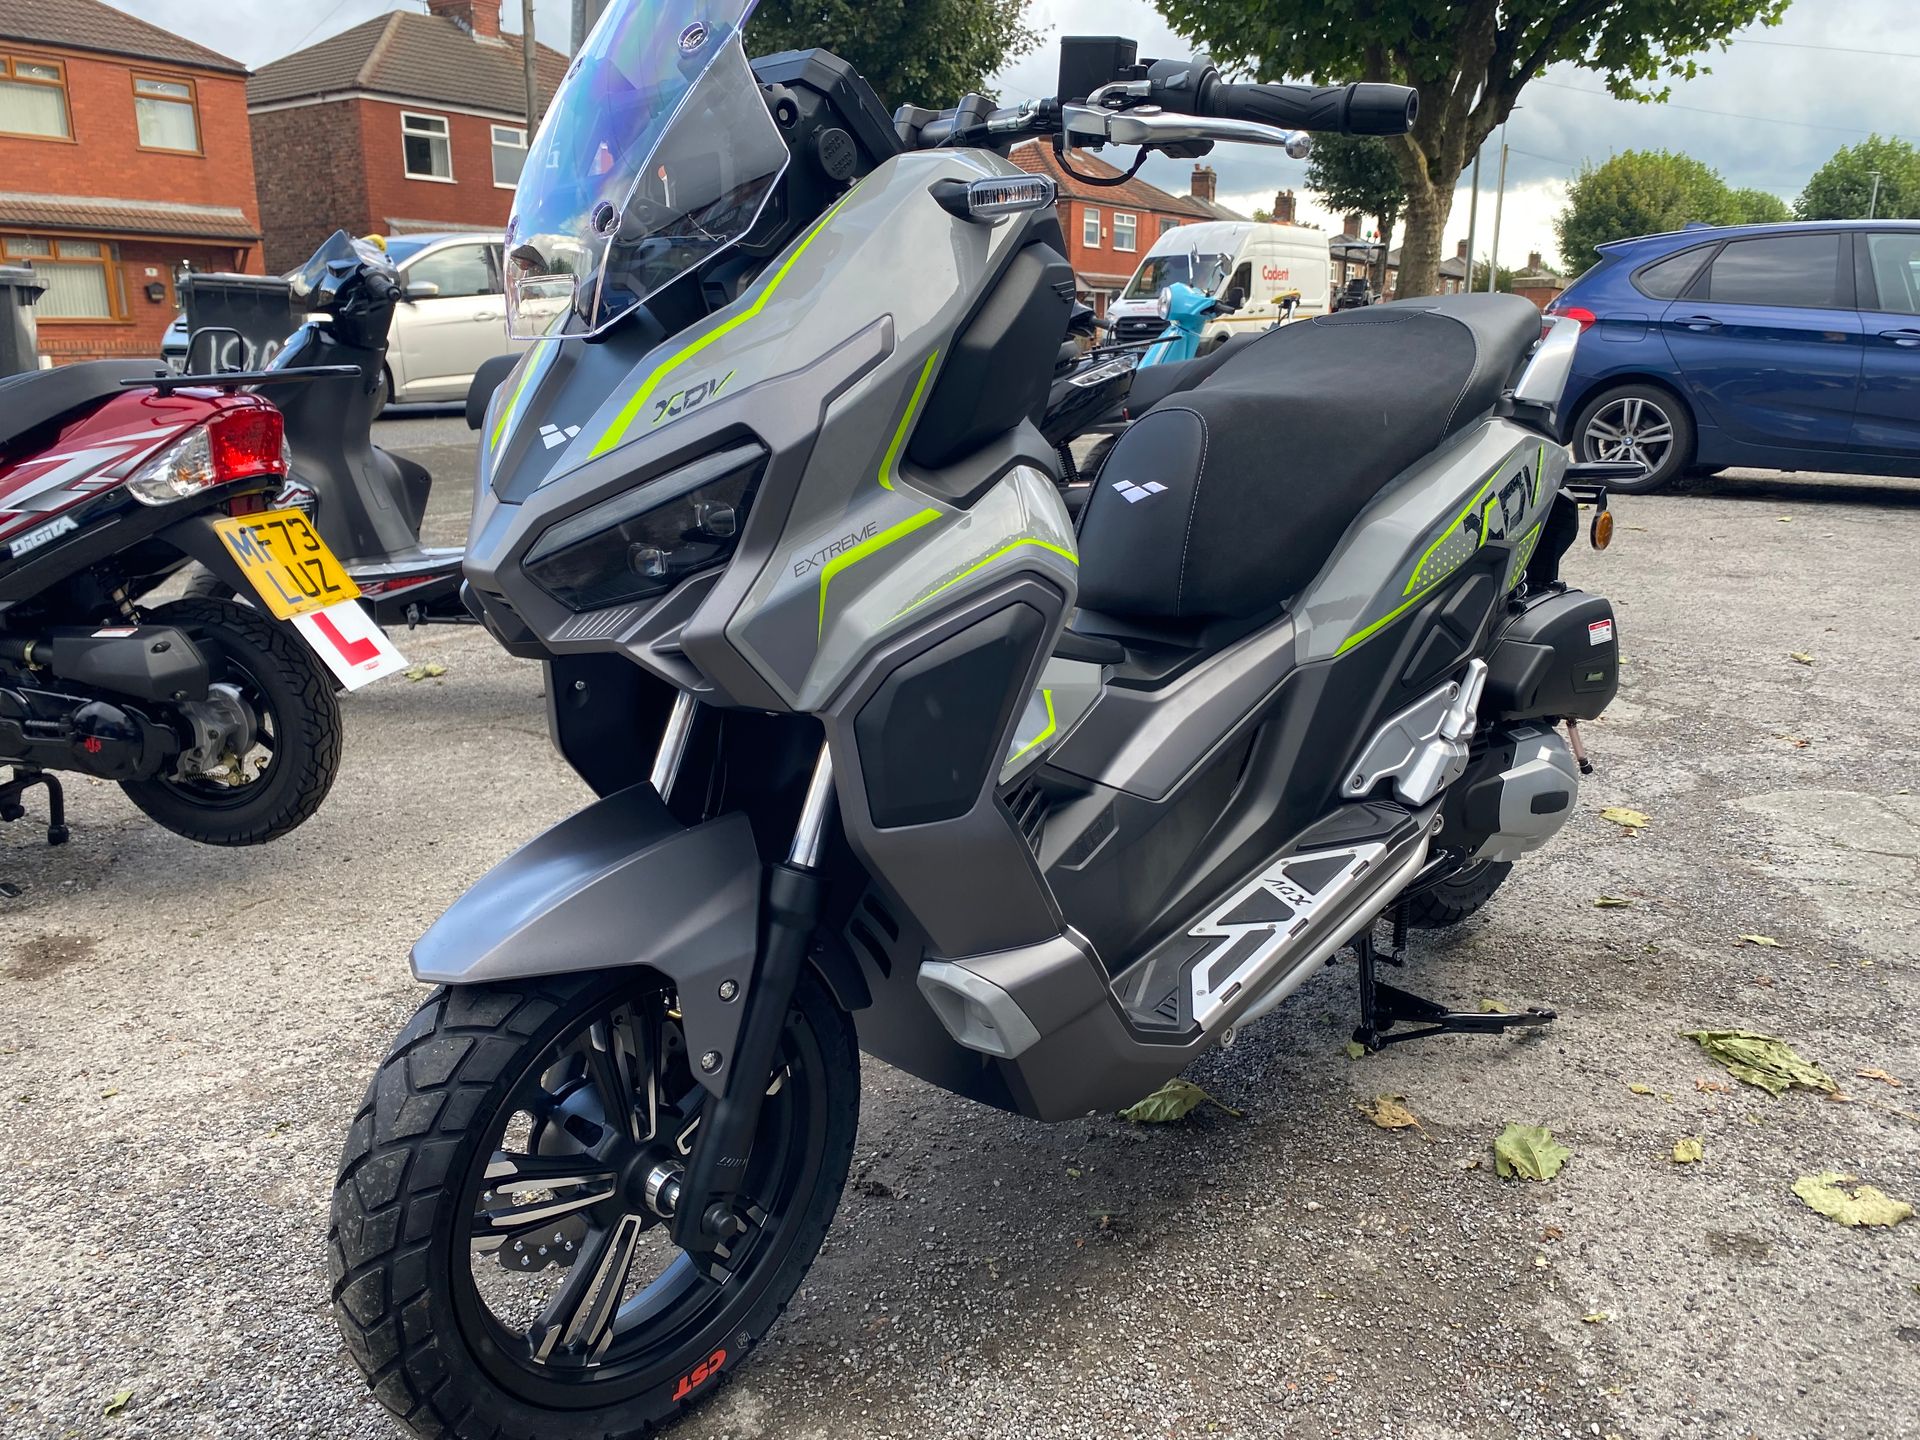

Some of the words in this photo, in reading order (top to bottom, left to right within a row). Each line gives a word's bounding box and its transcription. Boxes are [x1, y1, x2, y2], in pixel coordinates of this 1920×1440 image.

[1262, 264, 1289, 281] Cadent
[653, 368, 737, 424] XDV
[1463, 444, 1544, 552] XDV
[225, 517, 321, 567] MF73
[793, 521, 878, 578] EXTREME
[266, 558, 341, 605] LUZ
[310, 611, 381, 667] L
[1263, 878, 1313, 906] XDV
[672, 1349, 727, 1402] CST
